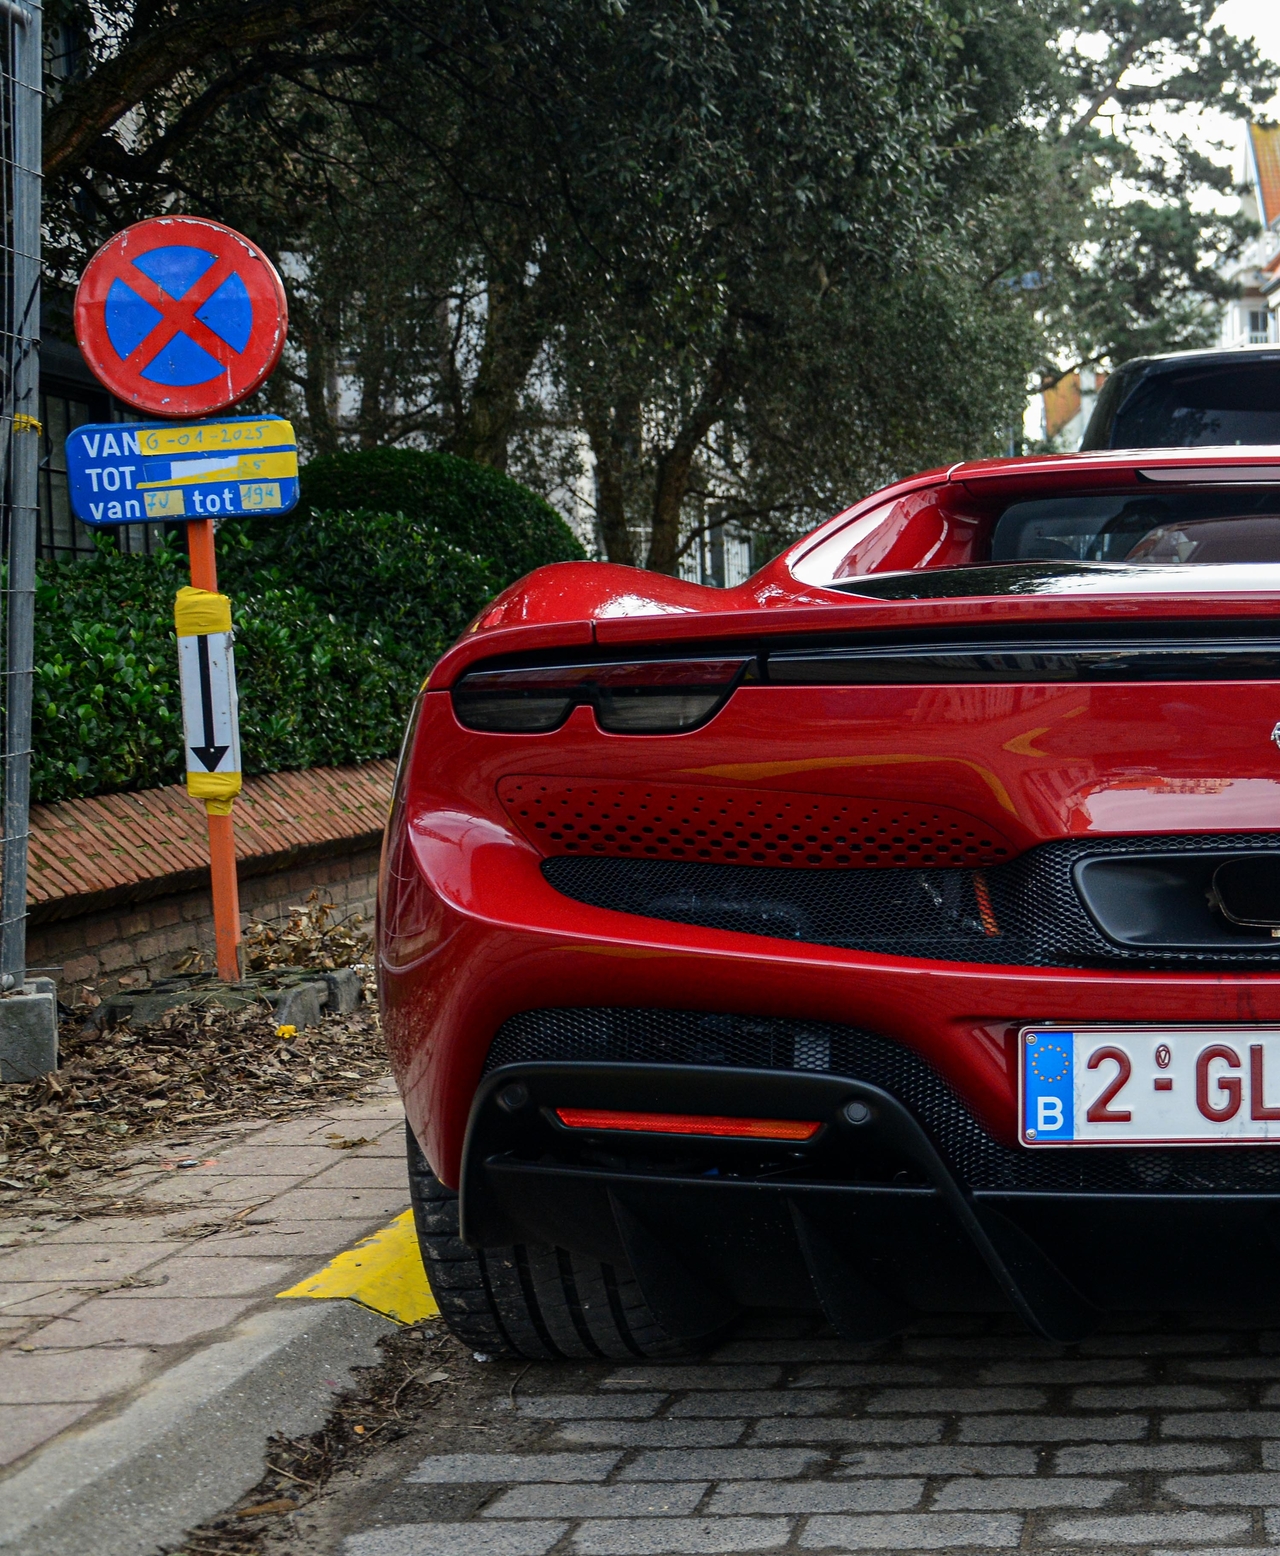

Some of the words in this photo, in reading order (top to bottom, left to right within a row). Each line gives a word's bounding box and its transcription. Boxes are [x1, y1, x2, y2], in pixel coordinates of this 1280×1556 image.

[81, 431, 140, 457] VAN
[85, 466, 135, 492] TOT
[89, 499, 140, 520] van
[193, 487, 234, 513] tot
[1036, 1096, 1064, 1130] B
